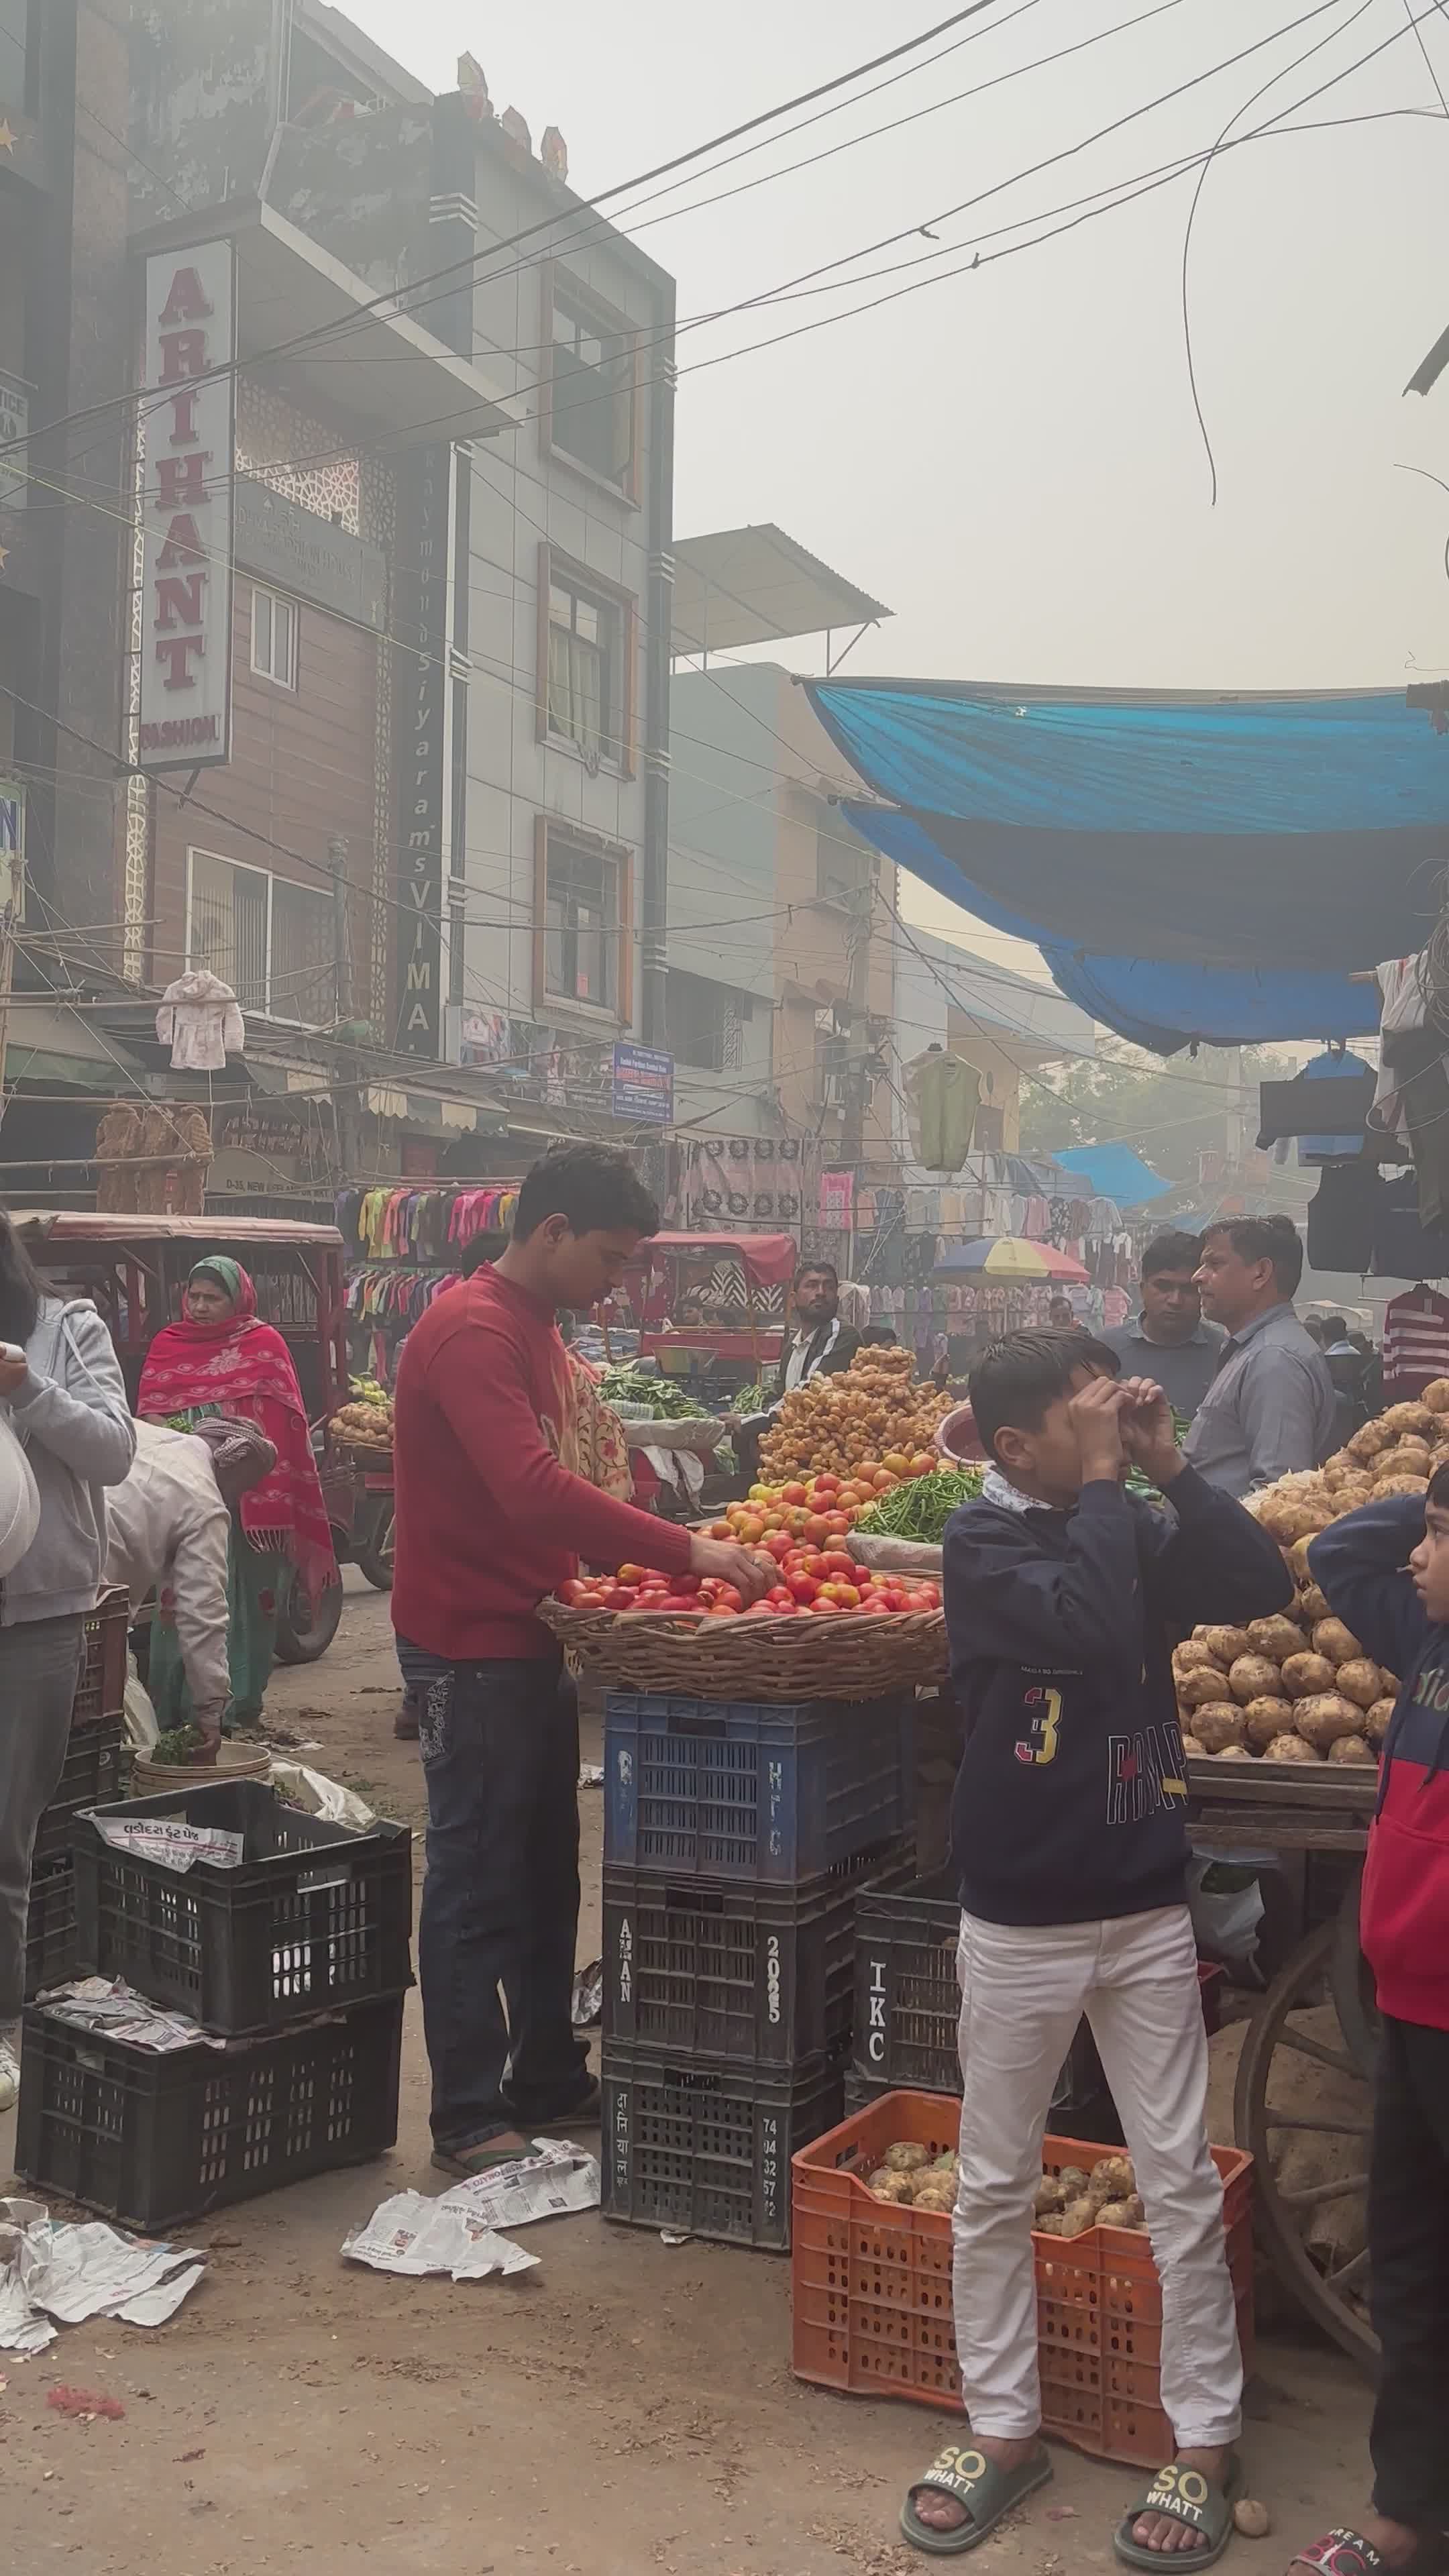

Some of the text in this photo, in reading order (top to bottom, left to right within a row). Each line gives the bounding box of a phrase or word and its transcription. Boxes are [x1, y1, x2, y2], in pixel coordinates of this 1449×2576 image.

[156, 266, 213, 689] ARIHANT
[1014, 1687, 1063, 1766] 3
[869, 1961, 887, 2061] IKC
[763, 2118, 777, 2135] 74
[763, 2159, 777, 2176] 32
[763, 2180, 776, 2196] 57
[934, 2447, 986, 2479] SO
[924, 2469, 975, 2493] WHATT
[1154, 2465, 1208, 2504] SO
[1146, 2491, 1202, 2521] WHATT
